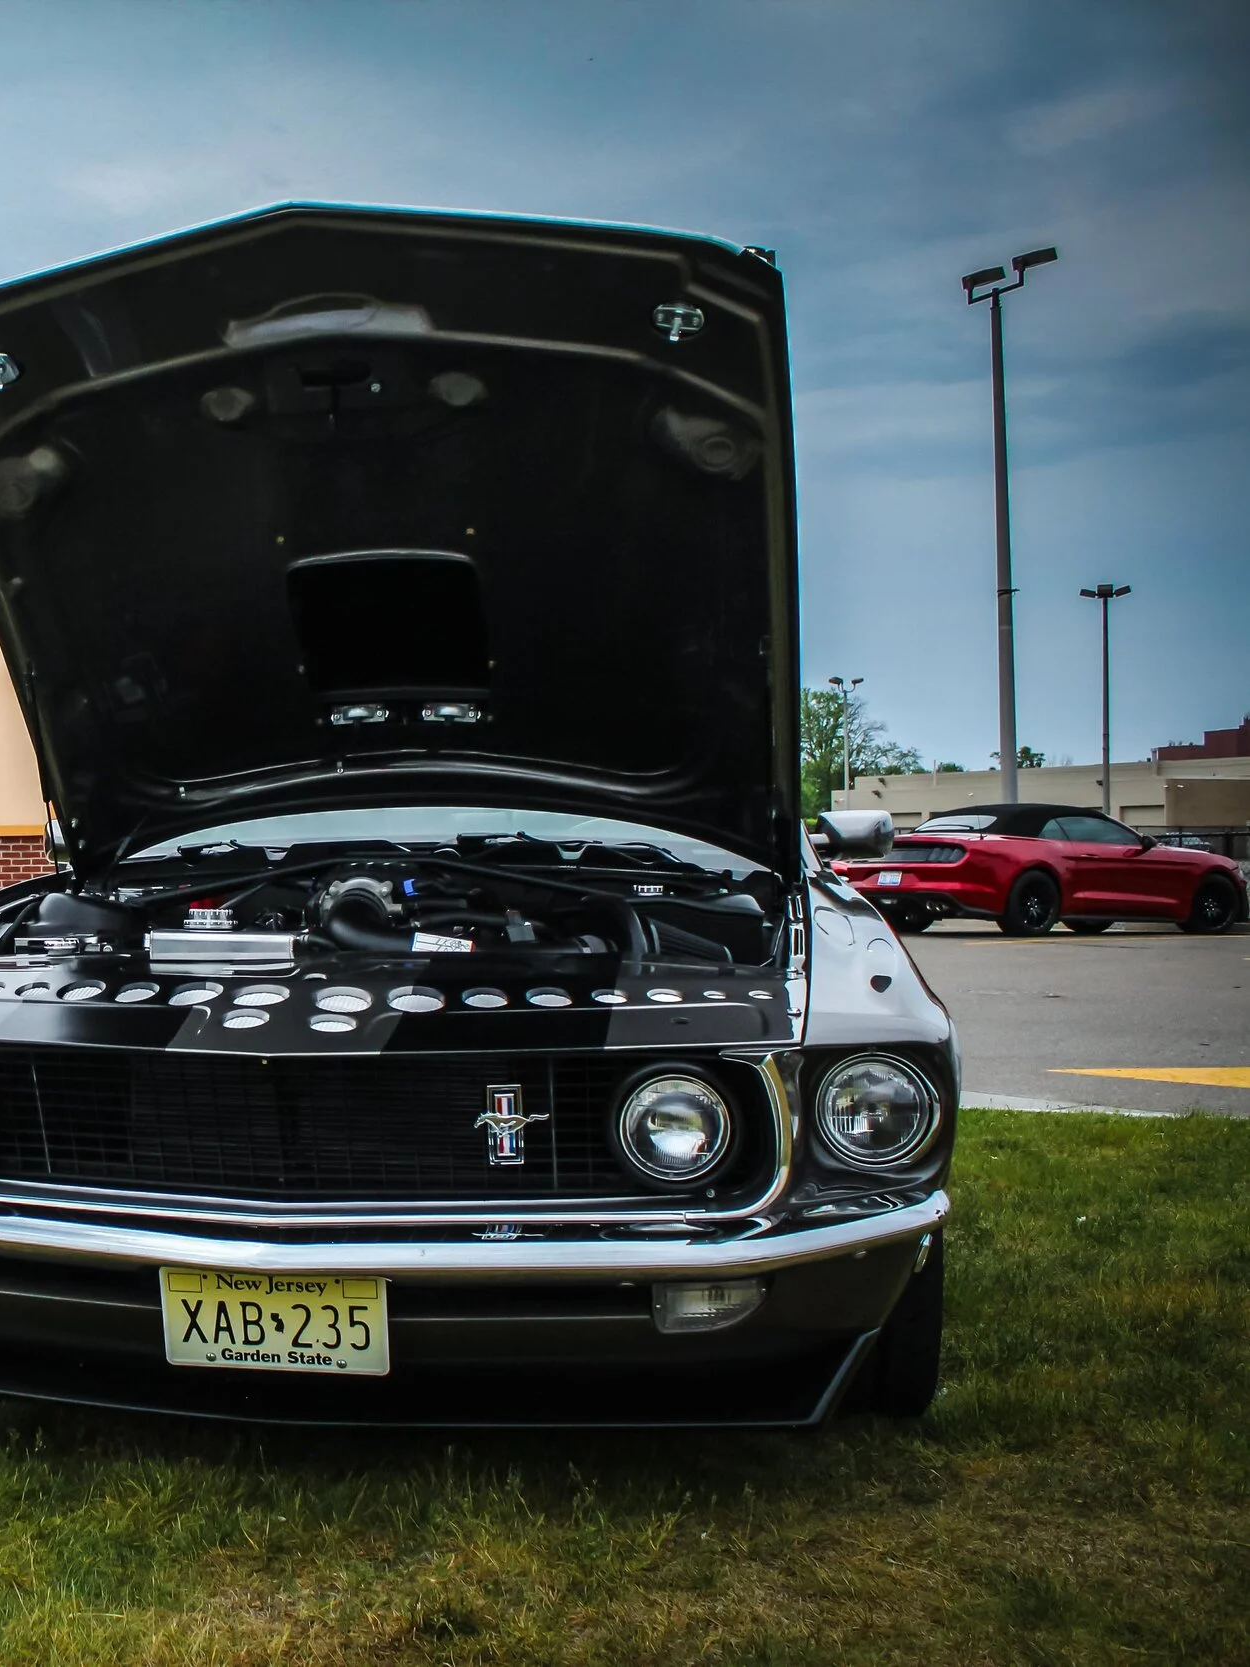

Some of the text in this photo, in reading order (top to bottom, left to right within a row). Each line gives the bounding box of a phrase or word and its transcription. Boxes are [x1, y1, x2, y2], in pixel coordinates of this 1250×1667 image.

[215, 1273, 328, 1296] New Jersey
[181, 1299, 371, 1351] XAB 235
[221, 1347, 333, 1366] Garden State
